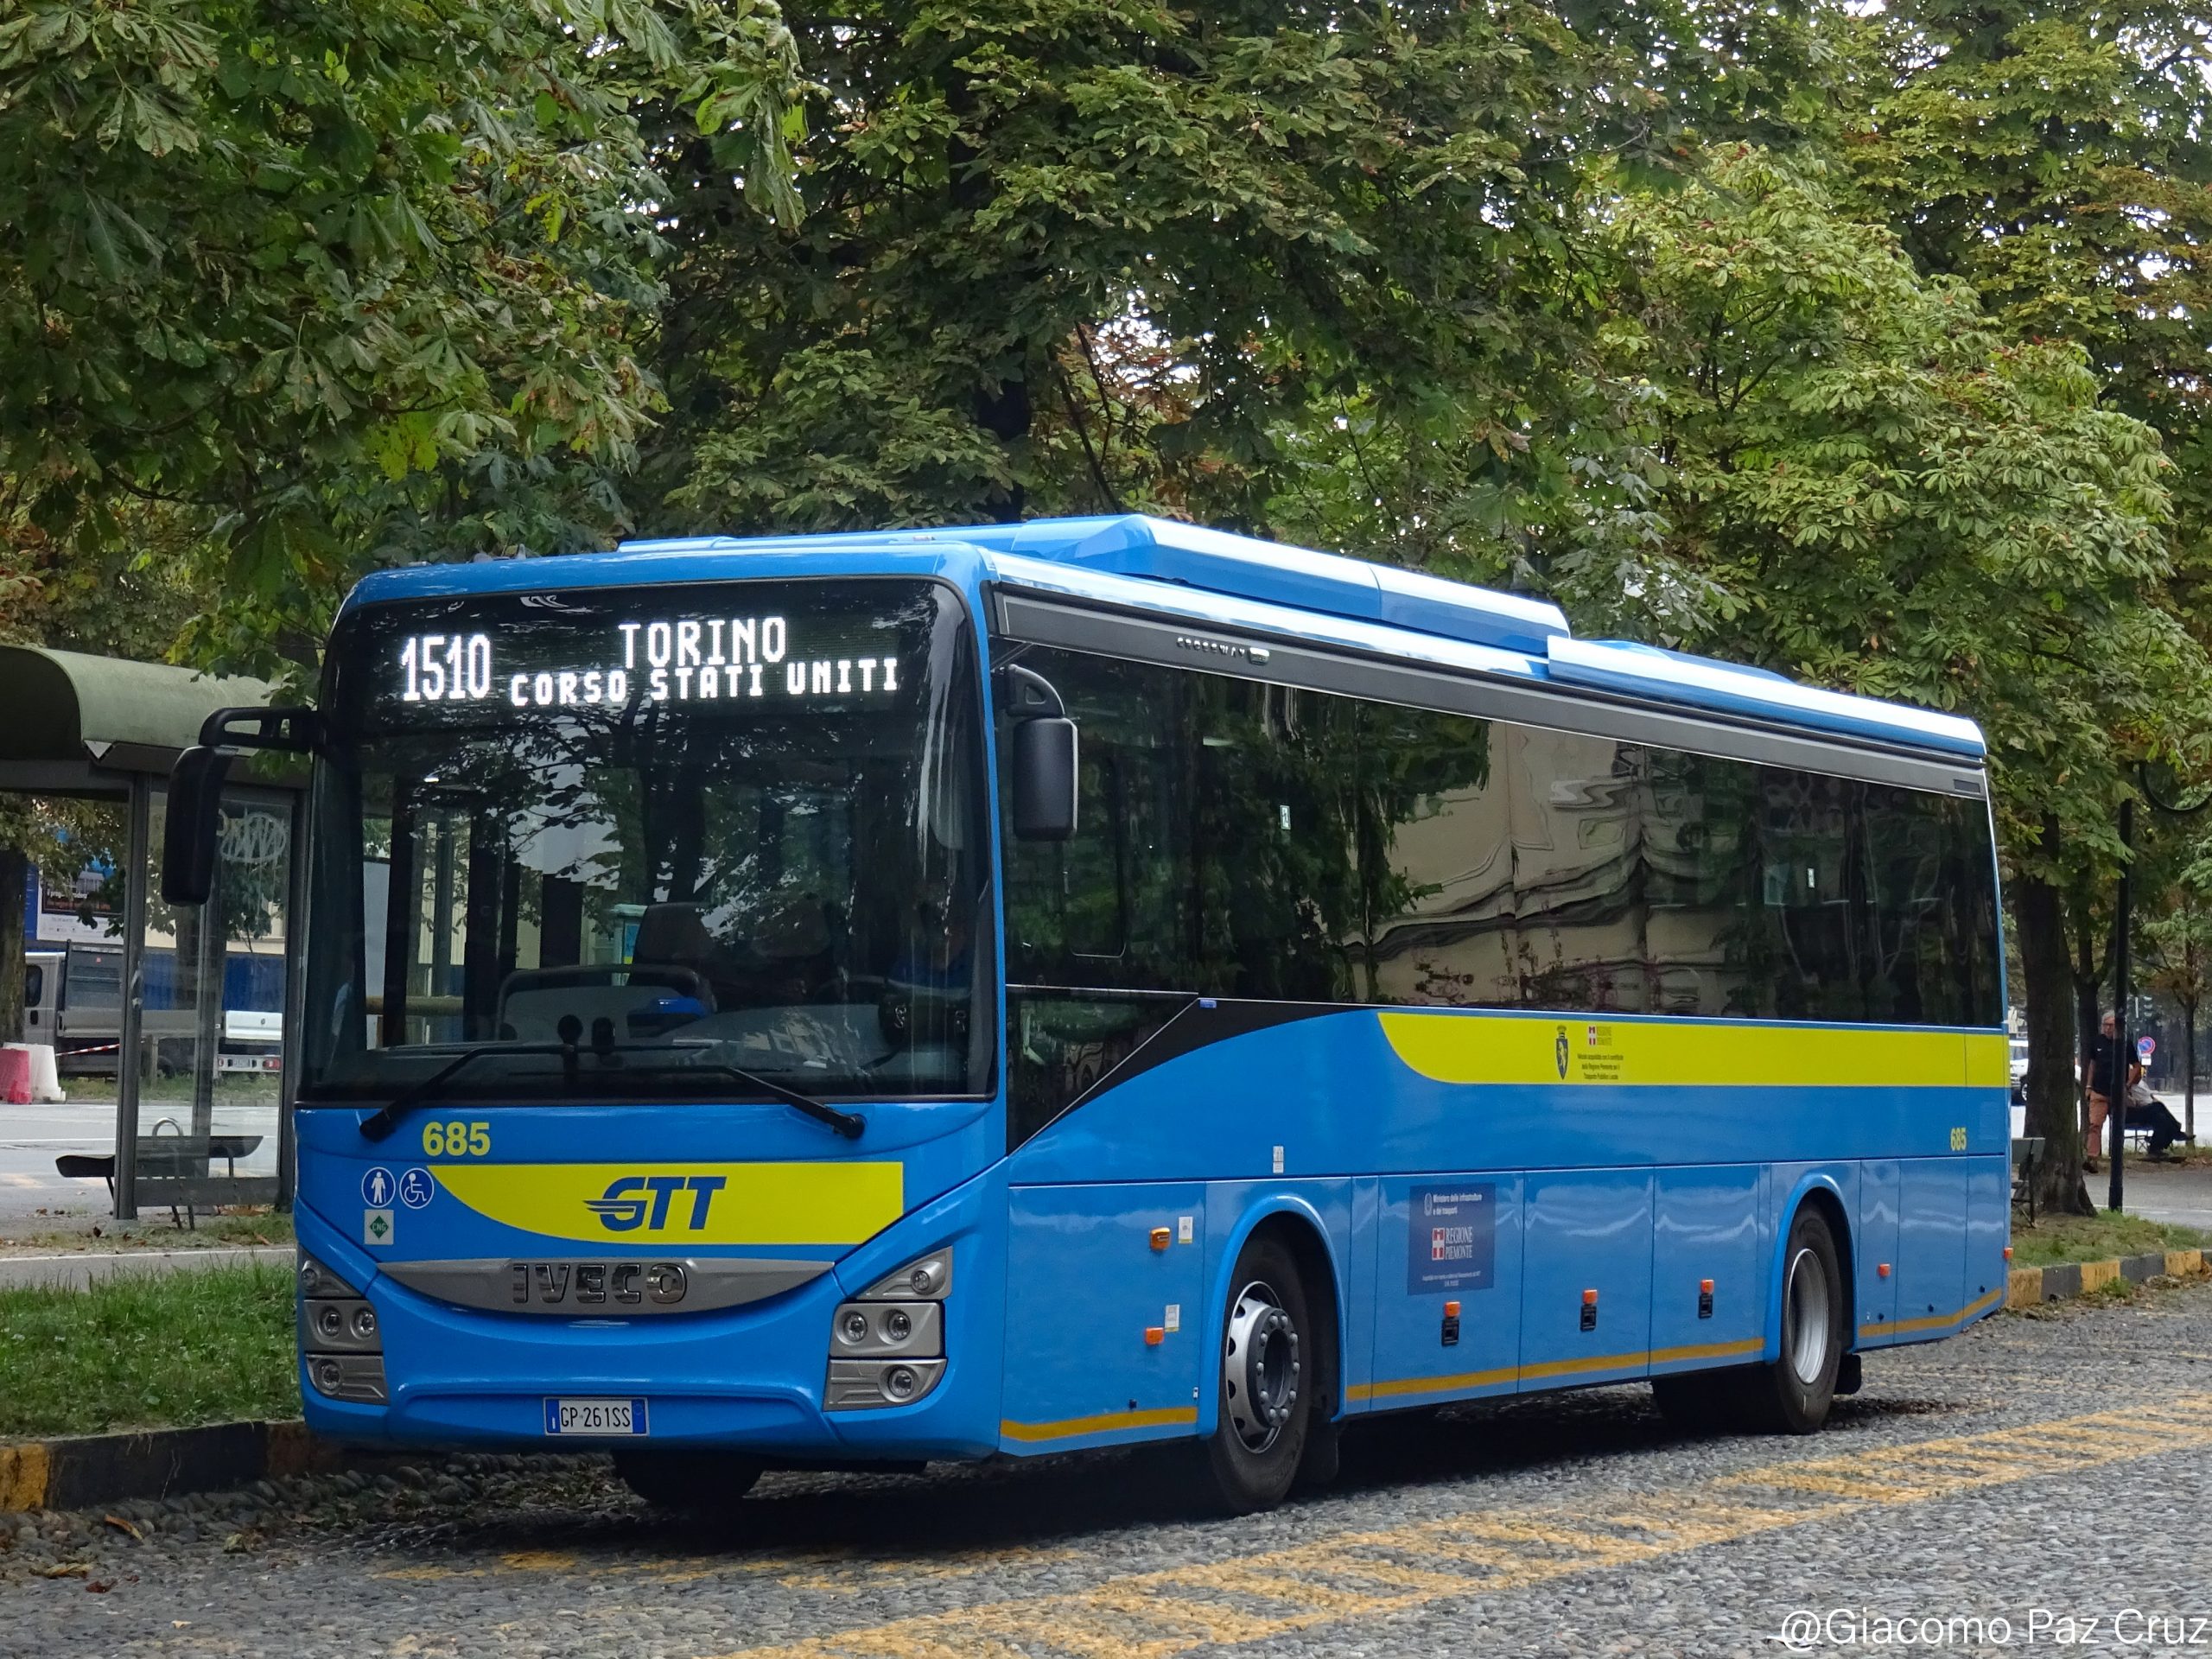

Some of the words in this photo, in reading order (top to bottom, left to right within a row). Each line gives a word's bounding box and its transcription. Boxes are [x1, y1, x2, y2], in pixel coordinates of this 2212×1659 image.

[619, 616, 787, 669] TORINO
[400, 633, 491, 702] 1510
[510, 669, 627, 707] CORSO
[650, 664, 763, 701] STATI
[786, 658, 899, 695] UNITI
[423, 1121, 491, 1156] 685
[1950, 1127, 1967, 1151] 685
[582, 1176, 728, 1232] GTT
[372, 1222, 387, 1231] CNG
[1446, 1226, 1473, 1244] REGIONE
[1445, 1244, 1473, 1261] PIEMONTE
[512, 1263, 688, 1305] IVECO
